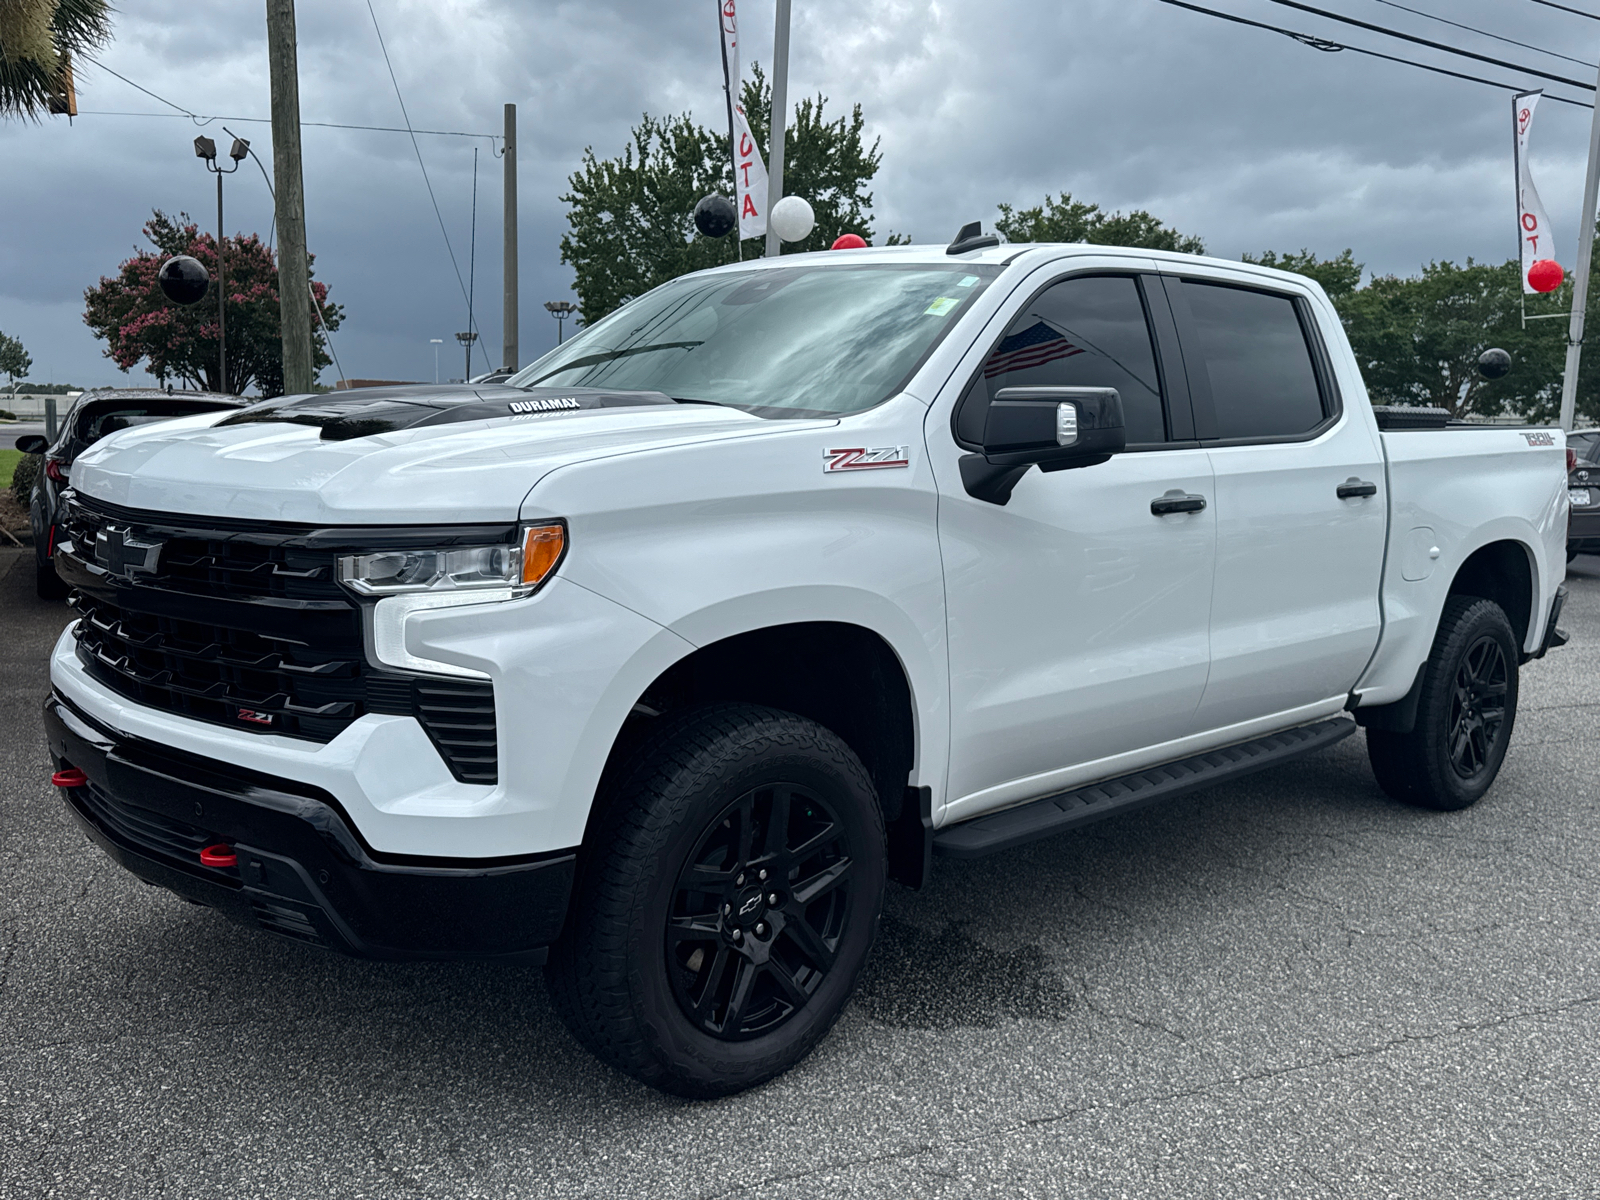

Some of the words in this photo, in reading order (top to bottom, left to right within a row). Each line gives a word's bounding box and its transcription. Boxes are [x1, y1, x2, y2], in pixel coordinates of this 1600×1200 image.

[508, 398, 580, 413] DURAMAX
[1519, 432, 1555, 441] TRAIL
[707, 753, 841, 806] BRIDGESTONE
